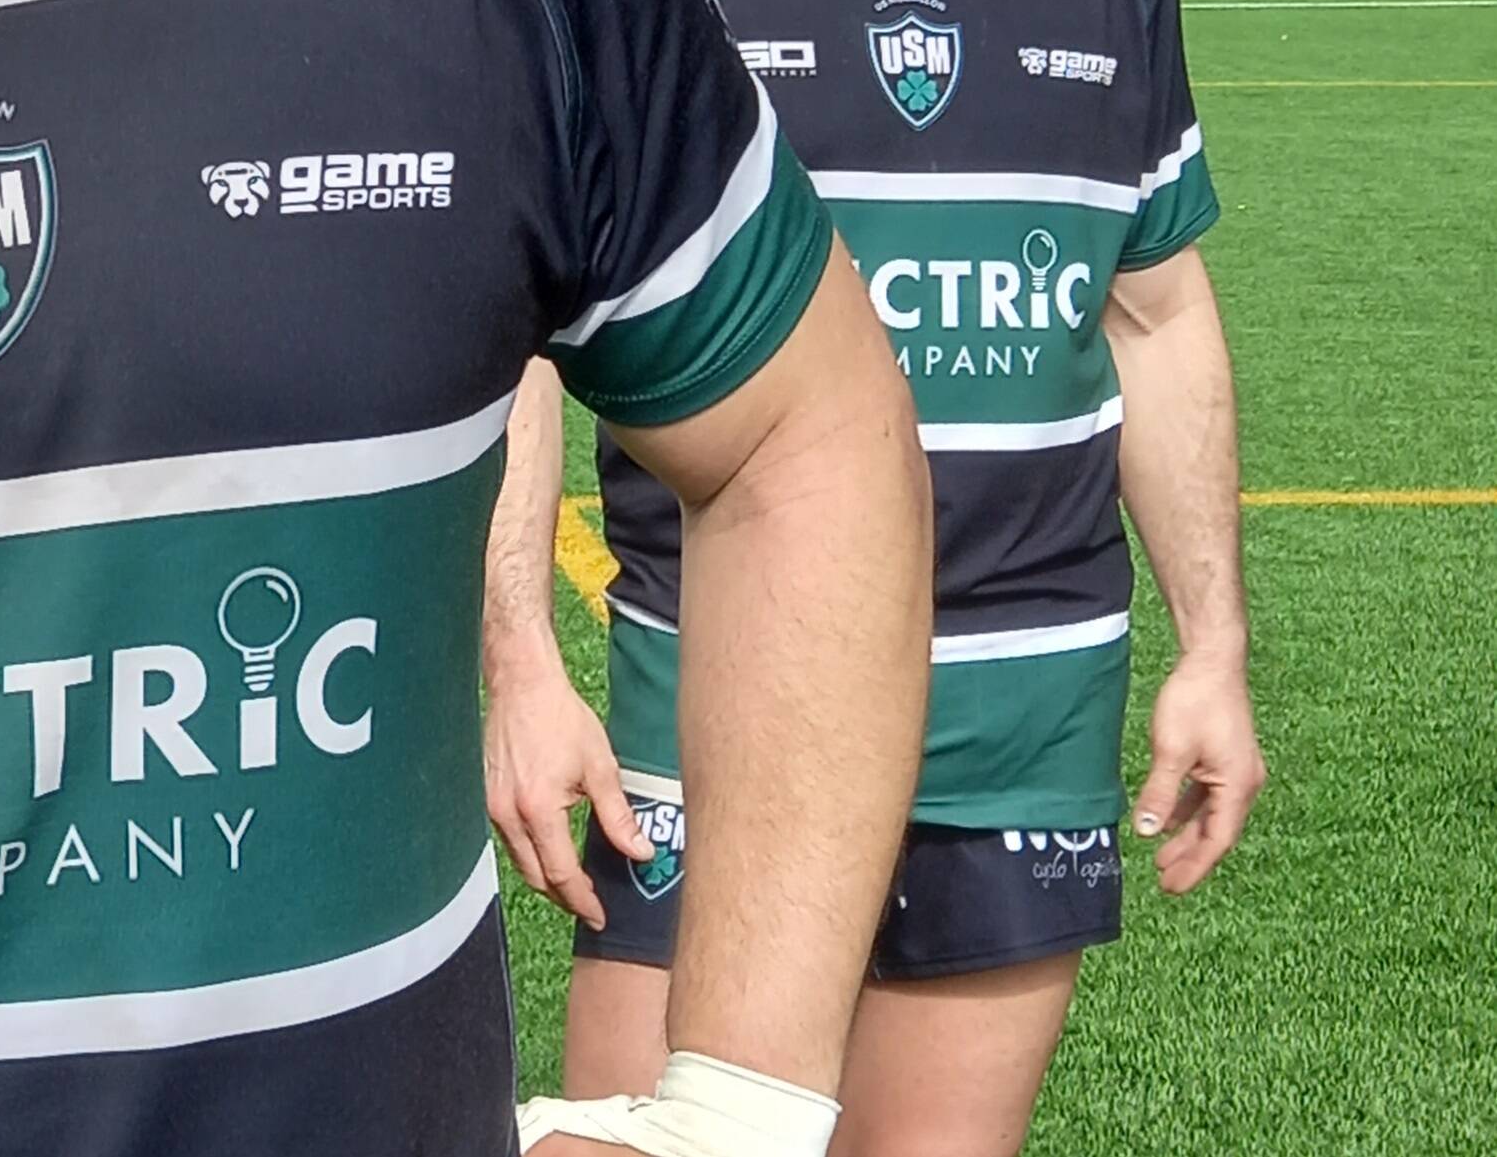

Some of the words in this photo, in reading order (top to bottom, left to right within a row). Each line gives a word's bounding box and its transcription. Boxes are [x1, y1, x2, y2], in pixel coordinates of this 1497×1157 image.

[880, 29, 951, 74] USM
[1049, 50, 1118, 77] game
[279, 152, 455, 205] game
[322, 187, 451, 211] SPORTS
